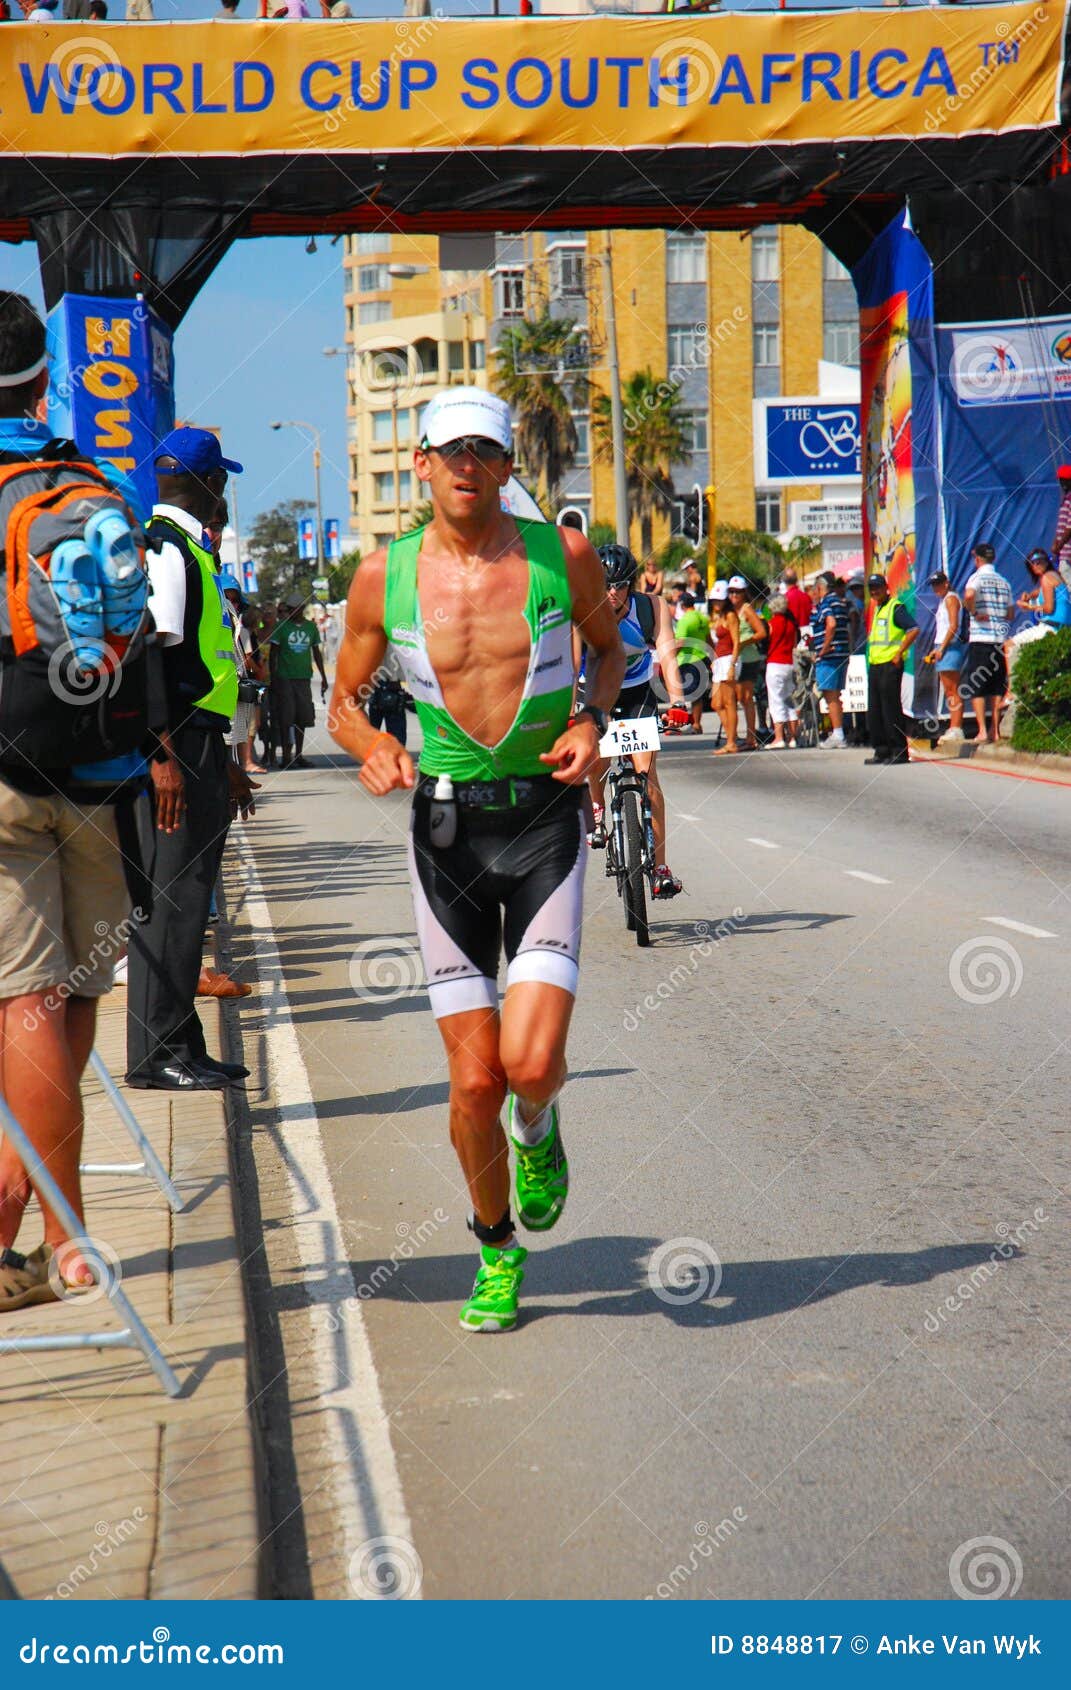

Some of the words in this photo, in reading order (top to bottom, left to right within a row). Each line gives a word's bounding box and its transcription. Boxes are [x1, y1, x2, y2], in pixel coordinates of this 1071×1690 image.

[20, 62, 275, 116] WORLD
[300, 60, 437, 111] CUP
[461, 58, 690, 110] SOUTH
[710, 47, 957, 105] AFRICA
[978, 40, 1019, 66] TM
[782, 407, 812, 421] THE
[848, 674, 863, 683] km
[849, 688, 864, 697] km
[850, 701, 866, 709] km
[611, 729, 638, 743] 1st
[621, 741, 649, 753] MAN
